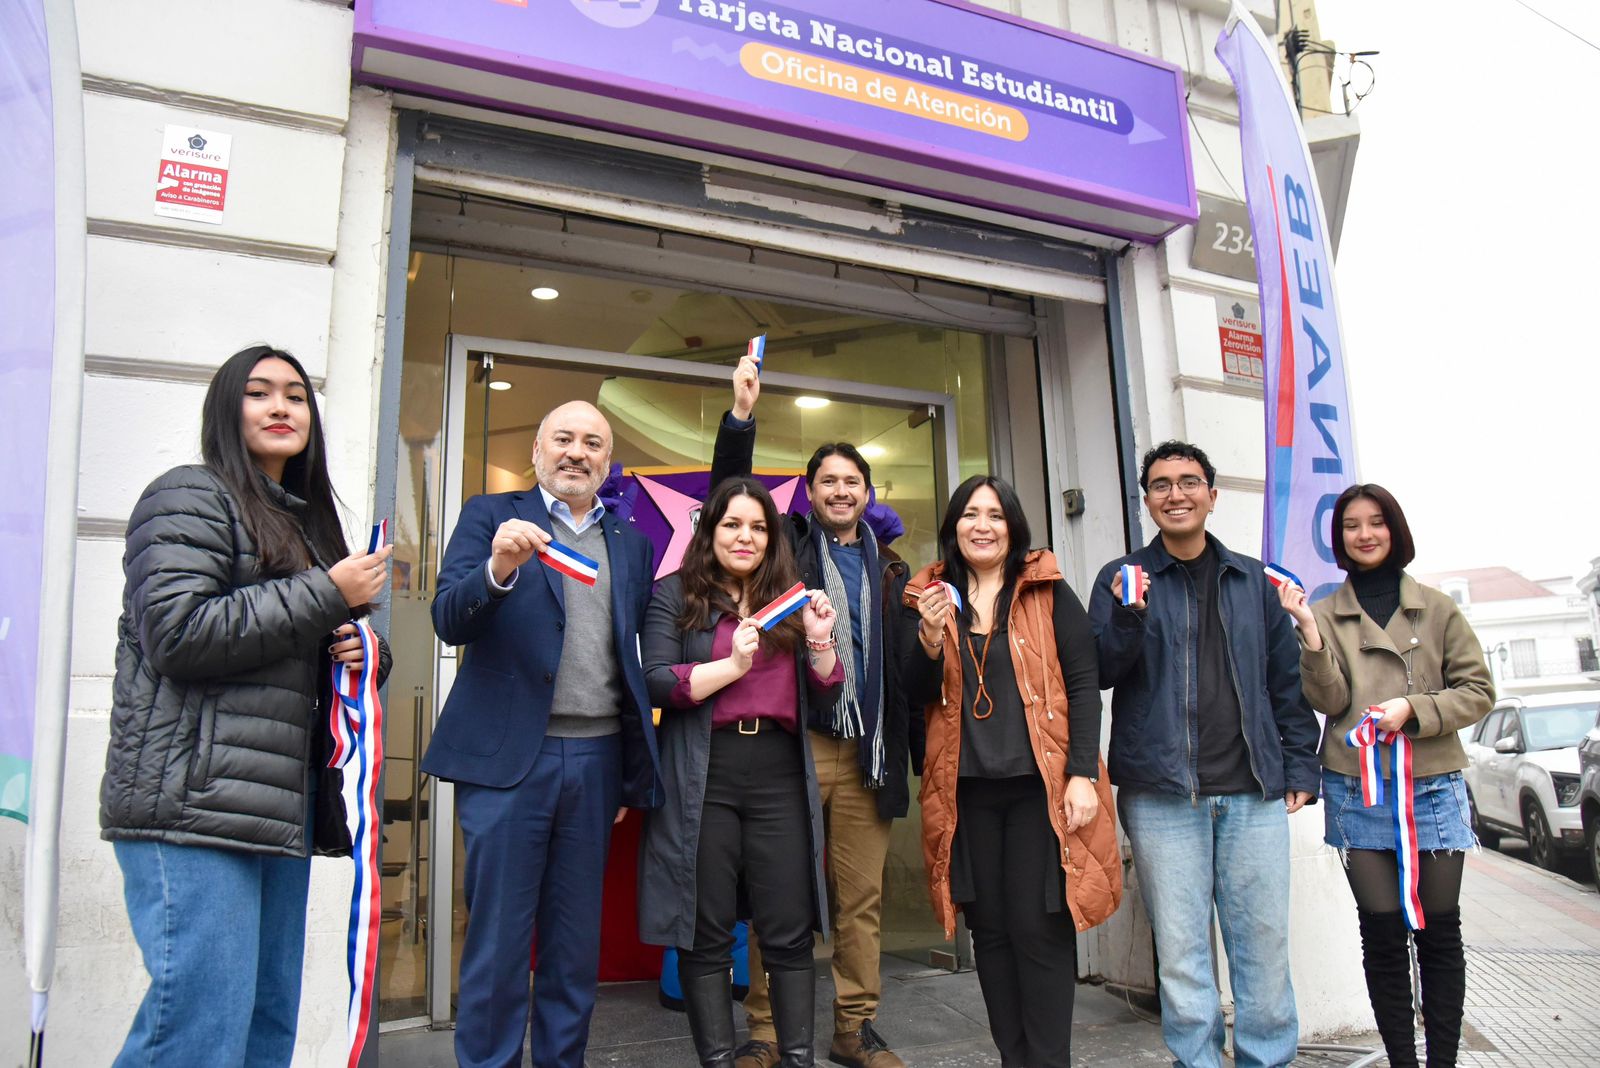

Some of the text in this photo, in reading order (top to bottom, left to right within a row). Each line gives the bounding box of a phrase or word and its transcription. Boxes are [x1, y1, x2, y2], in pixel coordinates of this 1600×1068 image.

[809, 19, 954, 81] Nacional
[960, 60, 1118, 126] Estudiantil
[761, 51, 1012, 132] Oficina de Atención
[170, 147, 221, 162] verisure
[163, 163, 223, 184] Alarma
[161, 191, 177, 199] Aviso
[183, 194, 220, 206] Carabineros
[1222, 316, 1257, 330] verisure
[1228, 330, 1254, 343] Alarma
